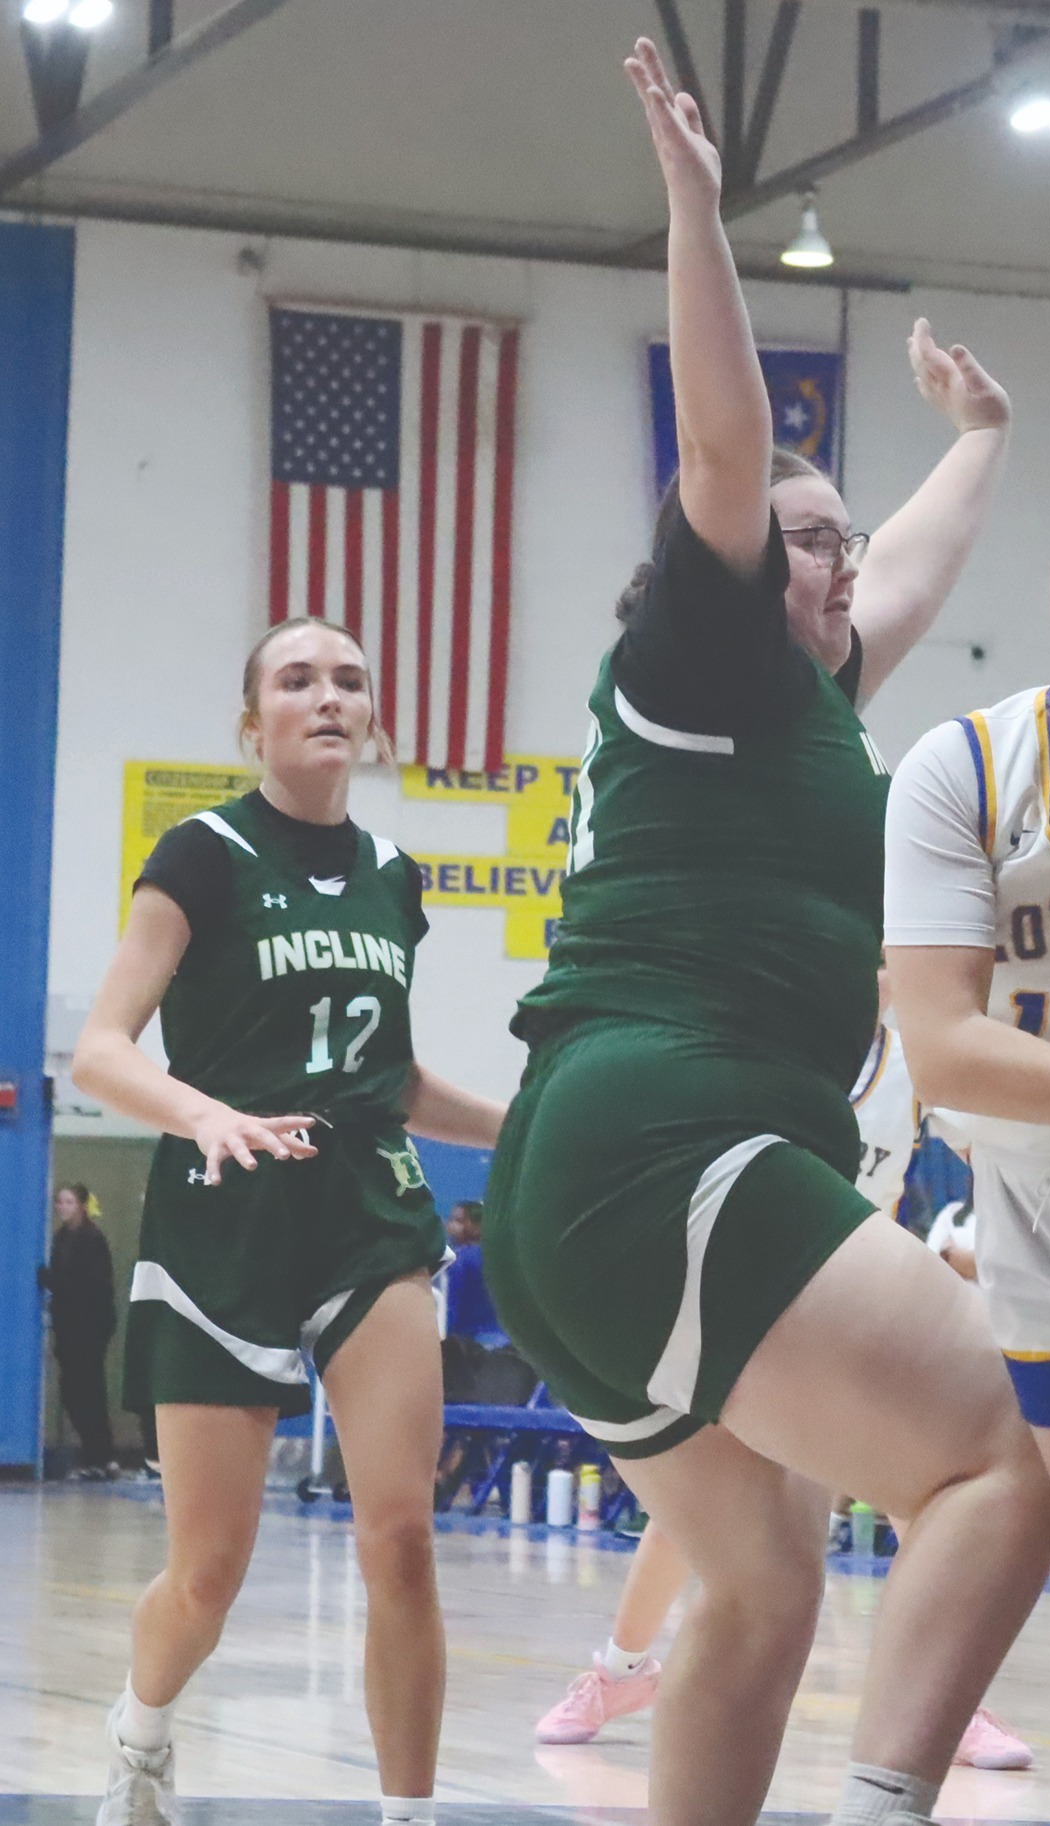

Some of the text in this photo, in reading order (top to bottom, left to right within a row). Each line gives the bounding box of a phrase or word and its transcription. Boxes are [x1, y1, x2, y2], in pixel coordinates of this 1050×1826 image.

[425, 764, 539, 793] KEEP
[421, 862, 569, 897] BELIEV
[257, 929, 407, 989] INCLINE
[305, 996, 381, 1074] 12
